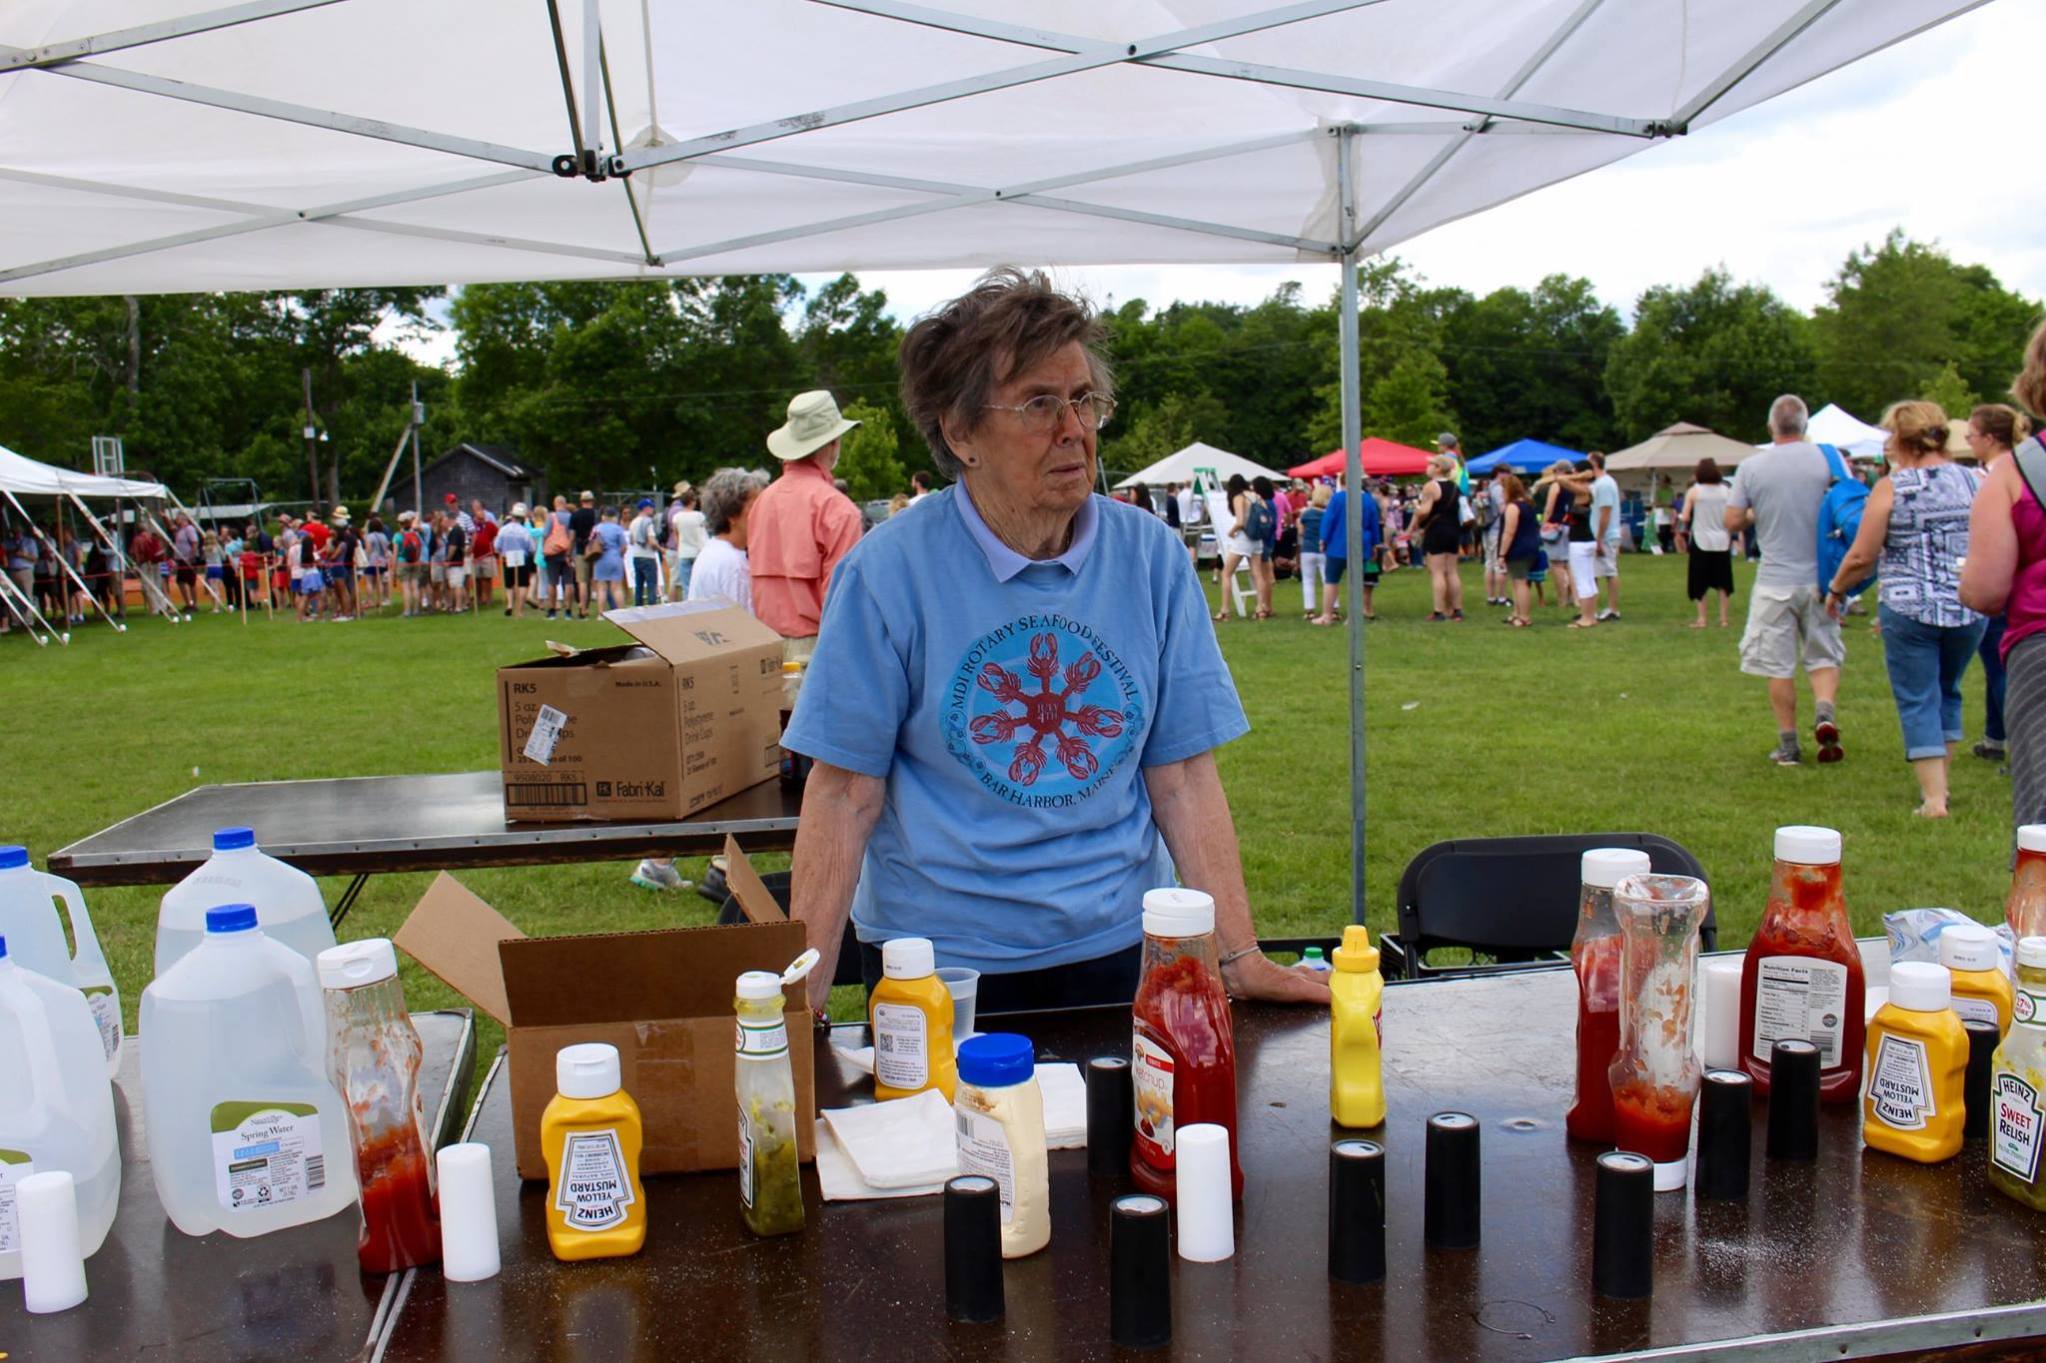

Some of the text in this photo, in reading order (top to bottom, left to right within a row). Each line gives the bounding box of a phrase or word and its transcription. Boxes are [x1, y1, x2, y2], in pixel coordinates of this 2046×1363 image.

[951, 614, 1139, 708] MDI ROTARY SEAFOOD FESTIVAL
[513, 683, 537, 694] RK5
[980, 772, 1009, 797] BAR
[1763, 964, 1789, 972] Nutrition
[1880, 1078, 1919, 1096] MUSTARD
[2003, 1079, 2031, 1103] HEINZ
[1883, 1090, 1913, 1104] YELLOW
[1882, 1102, 1913, 1119] HEINZ
[2000, 1103, 2031, 1130] SWEET
[241, 1130, 268, 1141] Spring
[269, 1125, 294, 1135] Water
[2000, 1119, 2030, 1146] RELISH
[570, 1180, 617, 1193] MUSTARD
[576, 1192, 612, 1203] YELLOW
[577, 1205, 614, 1219] HEINZ
